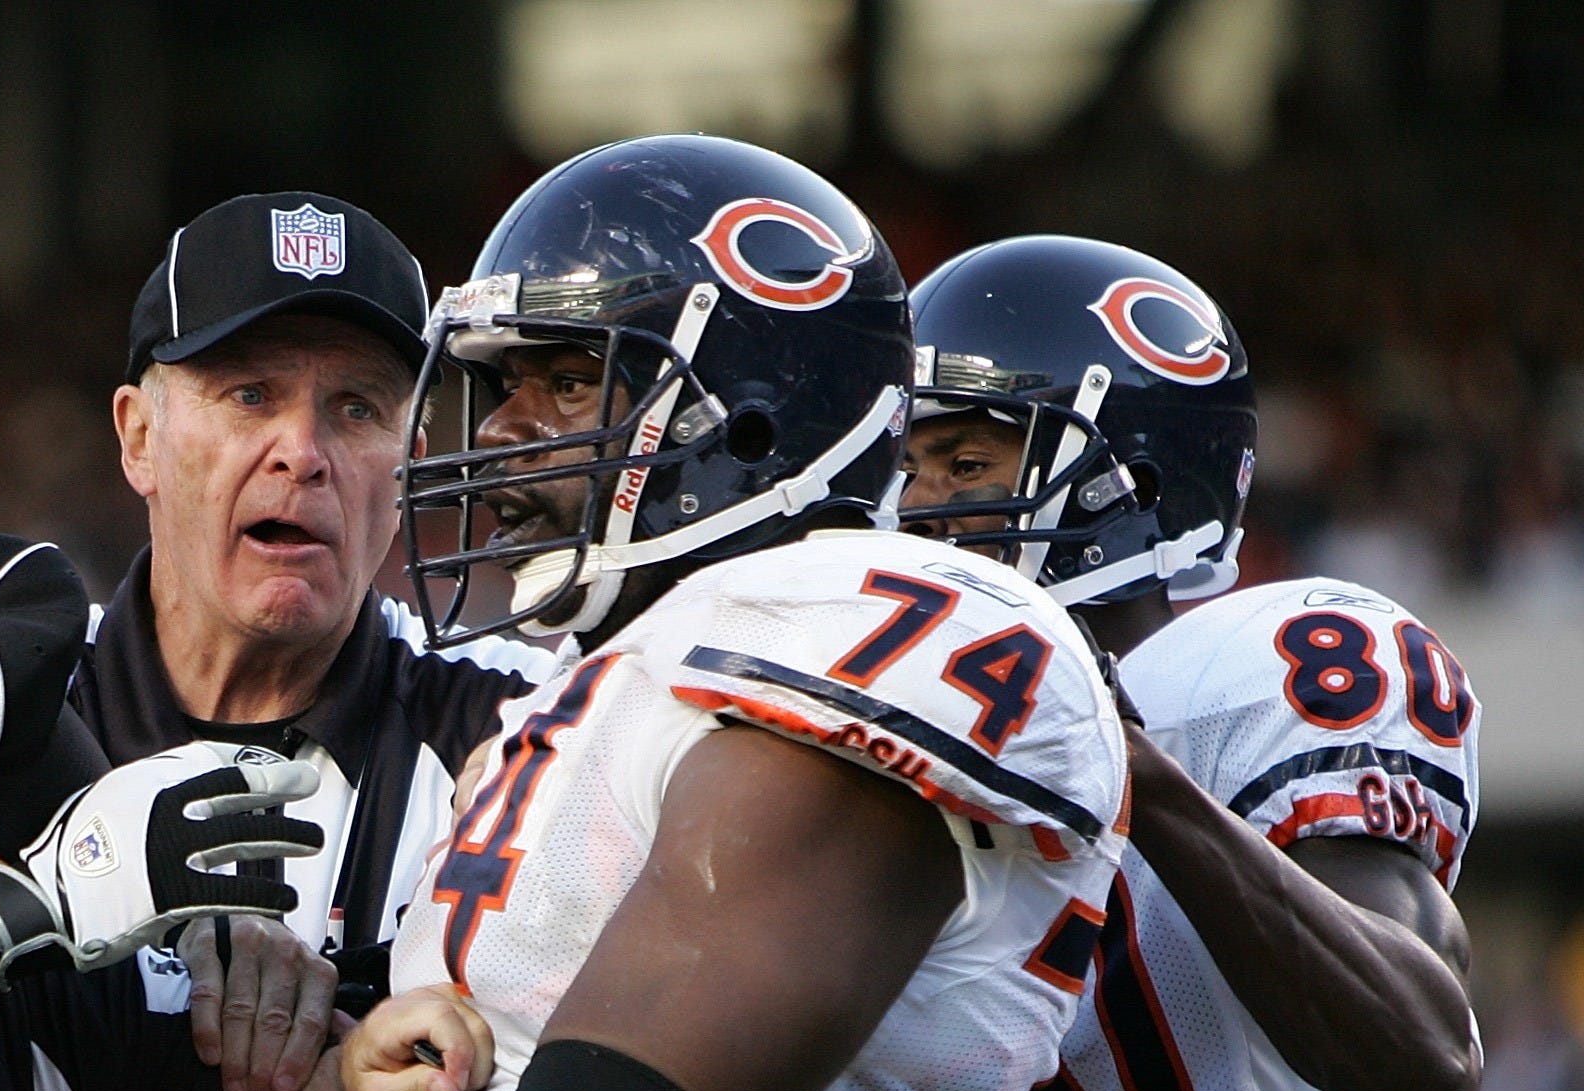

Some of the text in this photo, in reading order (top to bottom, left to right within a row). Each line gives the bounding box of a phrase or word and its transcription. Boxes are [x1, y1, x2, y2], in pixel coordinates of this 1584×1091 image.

[281, 234, 339, 270] NFL
[689, 197, 854, 312] C
[1086, 277, 1230, 386] C
[615, 422, 662, 514] Ridell
[824, 567, 1056, 760] 74
[1273, 610, 1475, 749] 80
